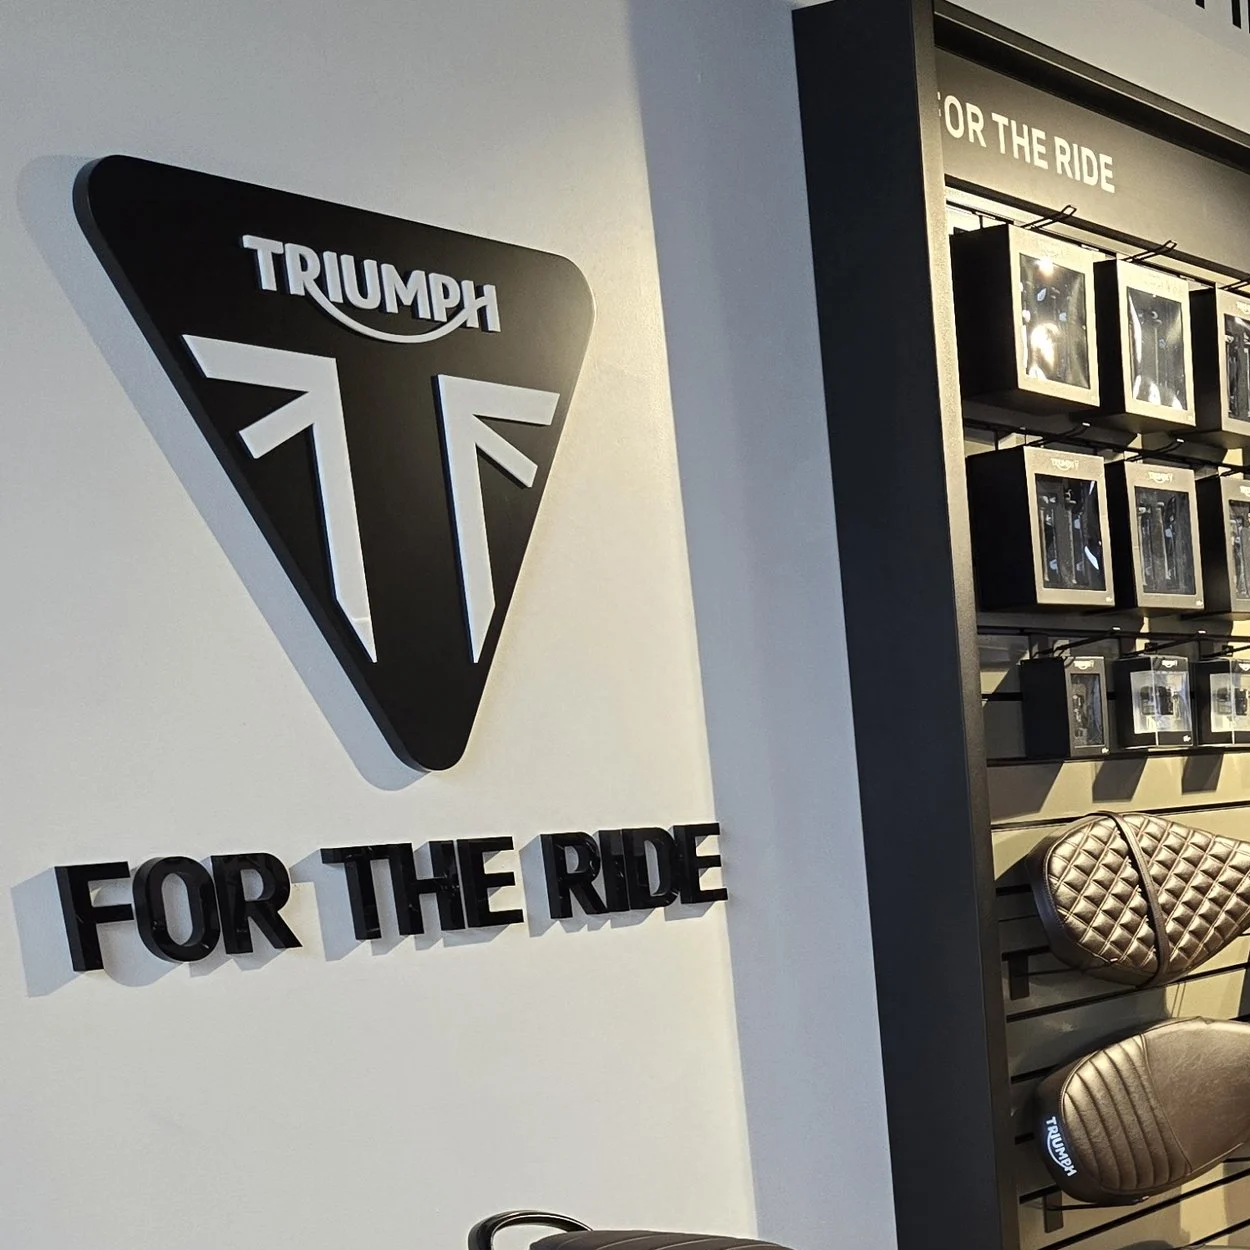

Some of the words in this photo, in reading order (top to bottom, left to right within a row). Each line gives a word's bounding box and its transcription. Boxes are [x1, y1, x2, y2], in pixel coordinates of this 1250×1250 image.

[938, 92, 987, 148] OR
[991, 113, 1048, 170] THE
[1054, 136, 1115, 193] RIDE
[242, 234, 501, 343] TRIUMPH
[55, 852, 303, 972] FOR
[321, 836, 525, 941] THE
[540, 822, 729, 919] RIDE
[1046, 1116, 1078, 1177] TRIUMPH
